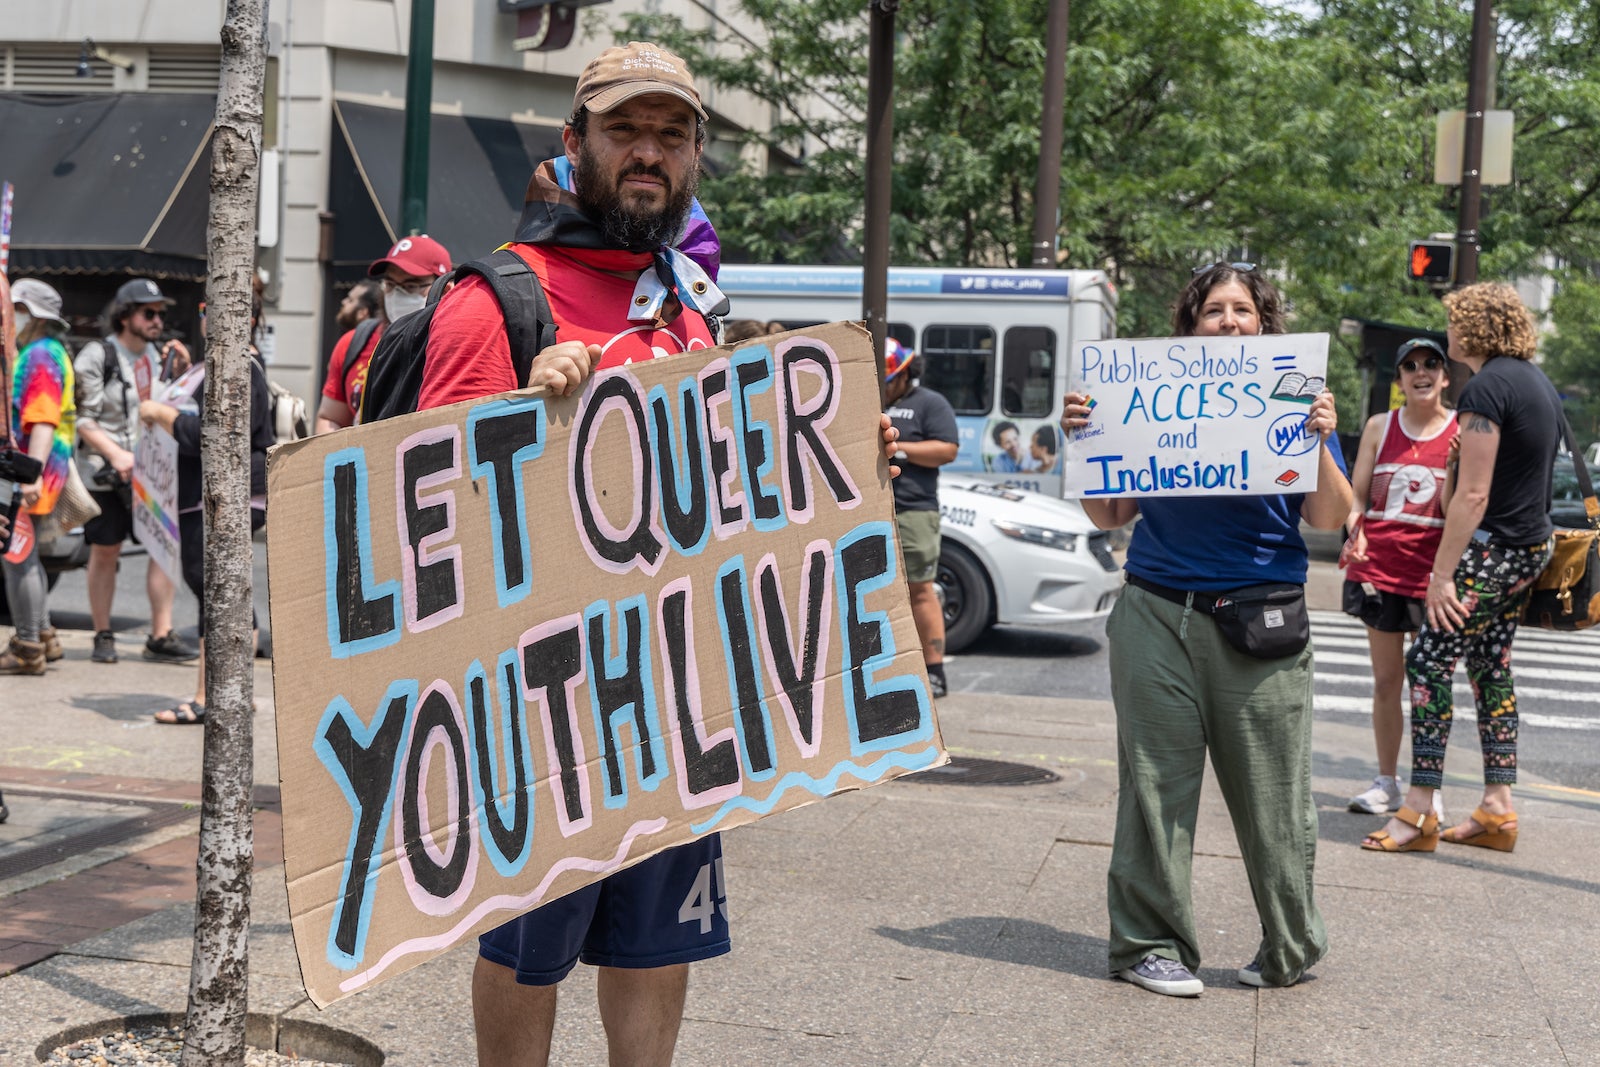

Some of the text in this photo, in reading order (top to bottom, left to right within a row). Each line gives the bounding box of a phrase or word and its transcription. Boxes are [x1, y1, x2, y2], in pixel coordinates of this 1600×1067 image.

[624, 57, 643, 65] Dick
[1081, 345, 1162, 384] Public
[1167, 344, 1259, 379] Schools
[1122, 381, 1267, 425] ACCESS
[1157, 422, 1198, 449] and
[1083, 450, 1249, 496] Inclusion!
[325, 337, 862, 659] LET QUEER
[314, 521, 933, 970] YOUTH LIVE
